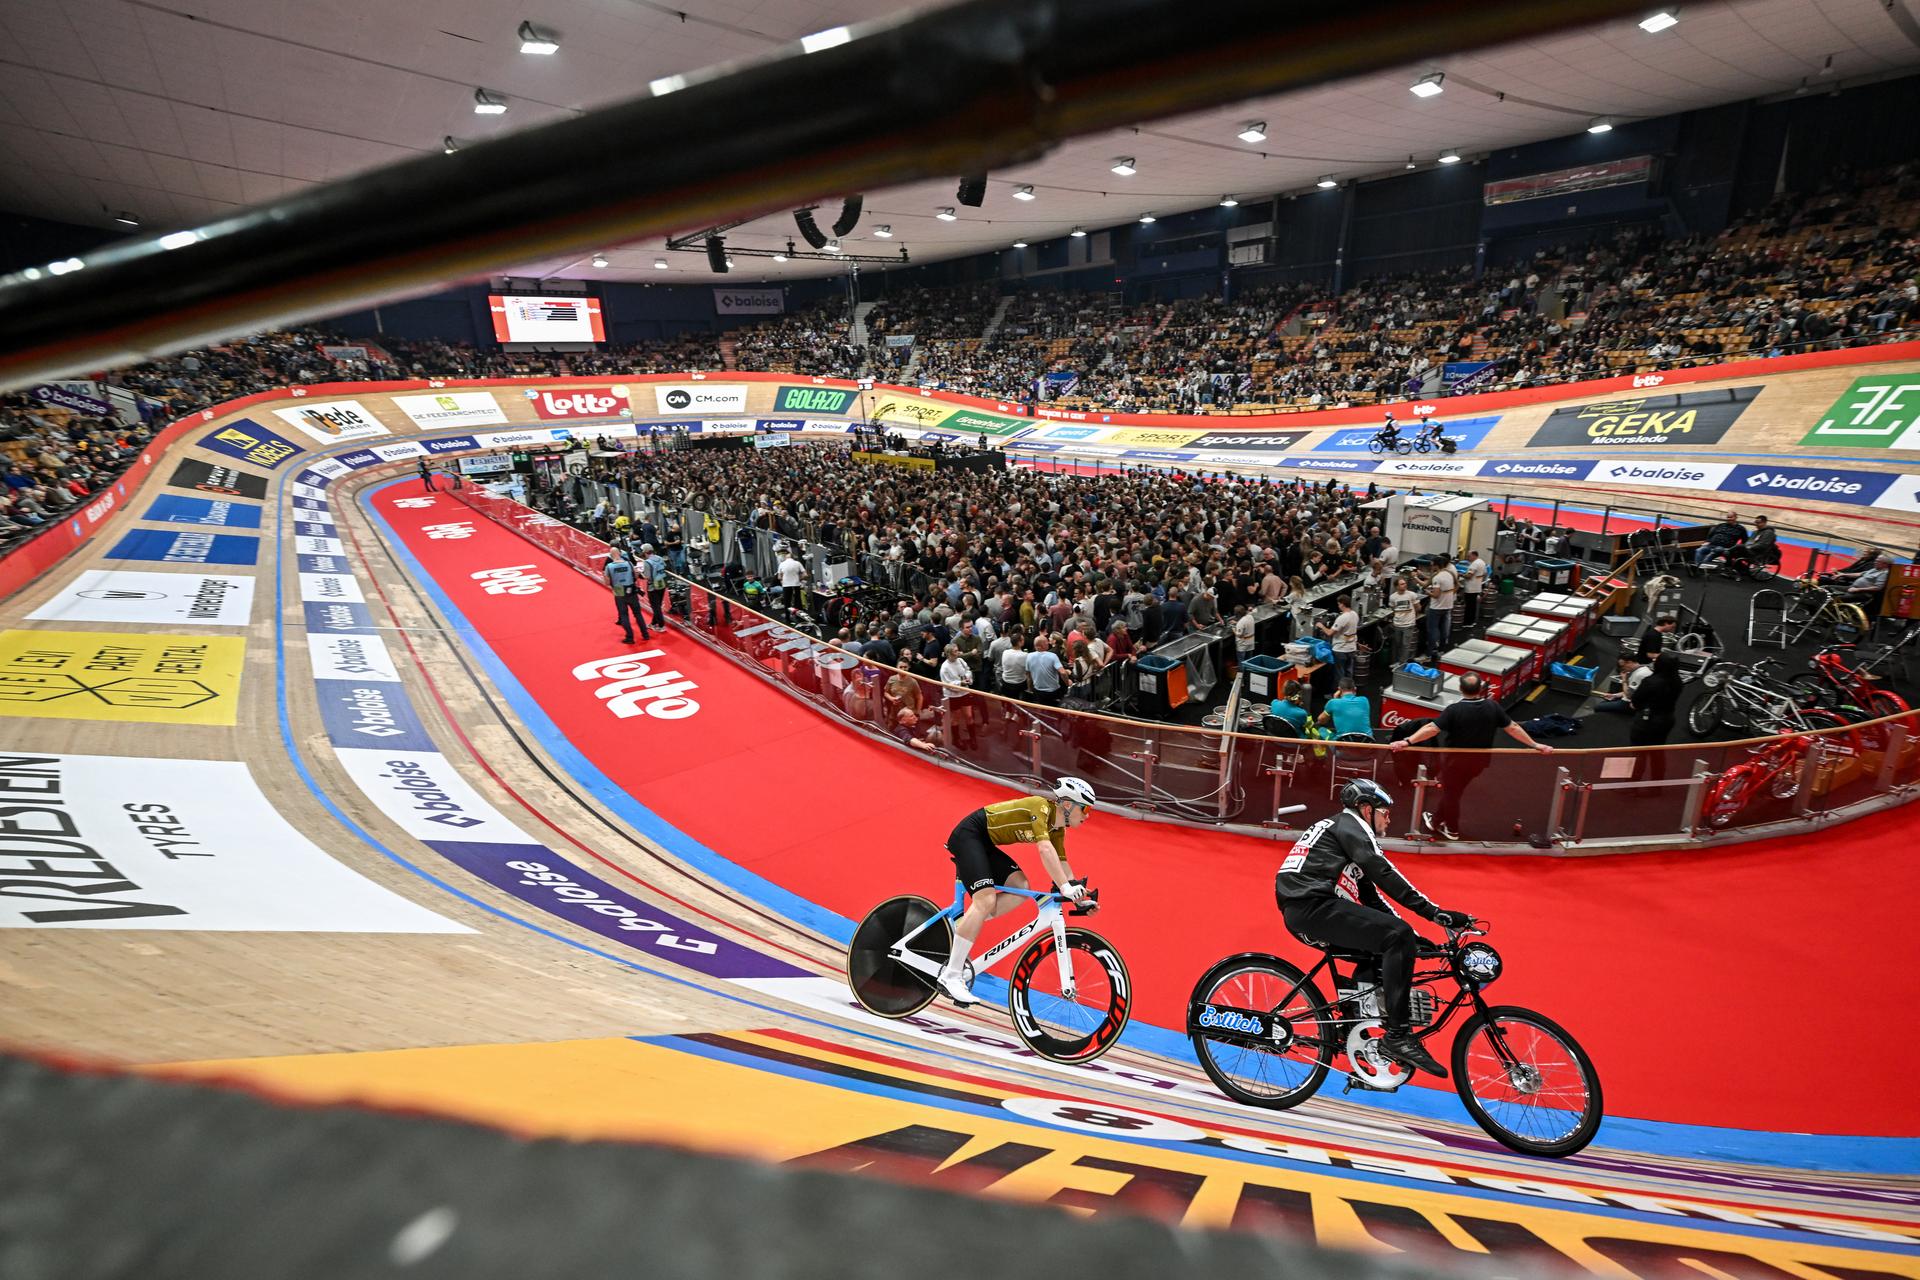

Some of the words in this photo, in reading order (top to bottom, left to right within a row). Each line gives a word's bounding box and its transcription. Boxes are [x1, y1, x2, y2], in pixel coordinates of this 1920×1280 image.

[735, 295, 779, 309] baloise
[1463, 368, 1496, 391] baloise
[53, 390, 107, 414] baloise
[543, 392, 617, 416] lotto
[695, 394, 739, 404] CM.com
[785, 389, 847, 411] GOLAZO
[308, 407, 363, 428] Pede
[720, 421, 748, 430] baloise
[771, 421, 798, 431] baloise
[1587, 409, 1697, 438] GEKA
[439, 439, 471, 450] baloise
[501, 434, 534, 443] baloise
[1592, 434, 1669, 445] Moorslede
[244, 439, 296, 468] NOBELS
[1311, 459, 1359, 469] baloise
[1408, 461, 1465, 473] baloise
[1511, 463, 1578, 475] baloise
[1629, 466, 1705, 482] baloise
[1769, 473, 1863, 495] baloise
[421, 521, 477, 539] lotto
[1402, 522, 1452, 534] VERKINDERE
[470, 564, 548, 595] lotto
[176, 578, 240, 619] wienerberger
[7, 650, 76, 669] LEVI
[84, 645, 147, 672] PARTY
[154, 644, 208, 675] RENTAL
[328, 638, 369, 666] baloise
[572, 648, 701, 720] lotto
[341, 687, 395, 726] baloise
[378, 760, 465, 812] baloise
[123, 803, 216, 860] TYRES
[506, 860, 675, 933] baloise
[984, 918, 1040, 962] RIDLEY
[1463, 953, 1500, 968] Estitch
[1199, 1005, 1264, 1035] Estitch
[1052, 1105, 1154, 1131] 8
